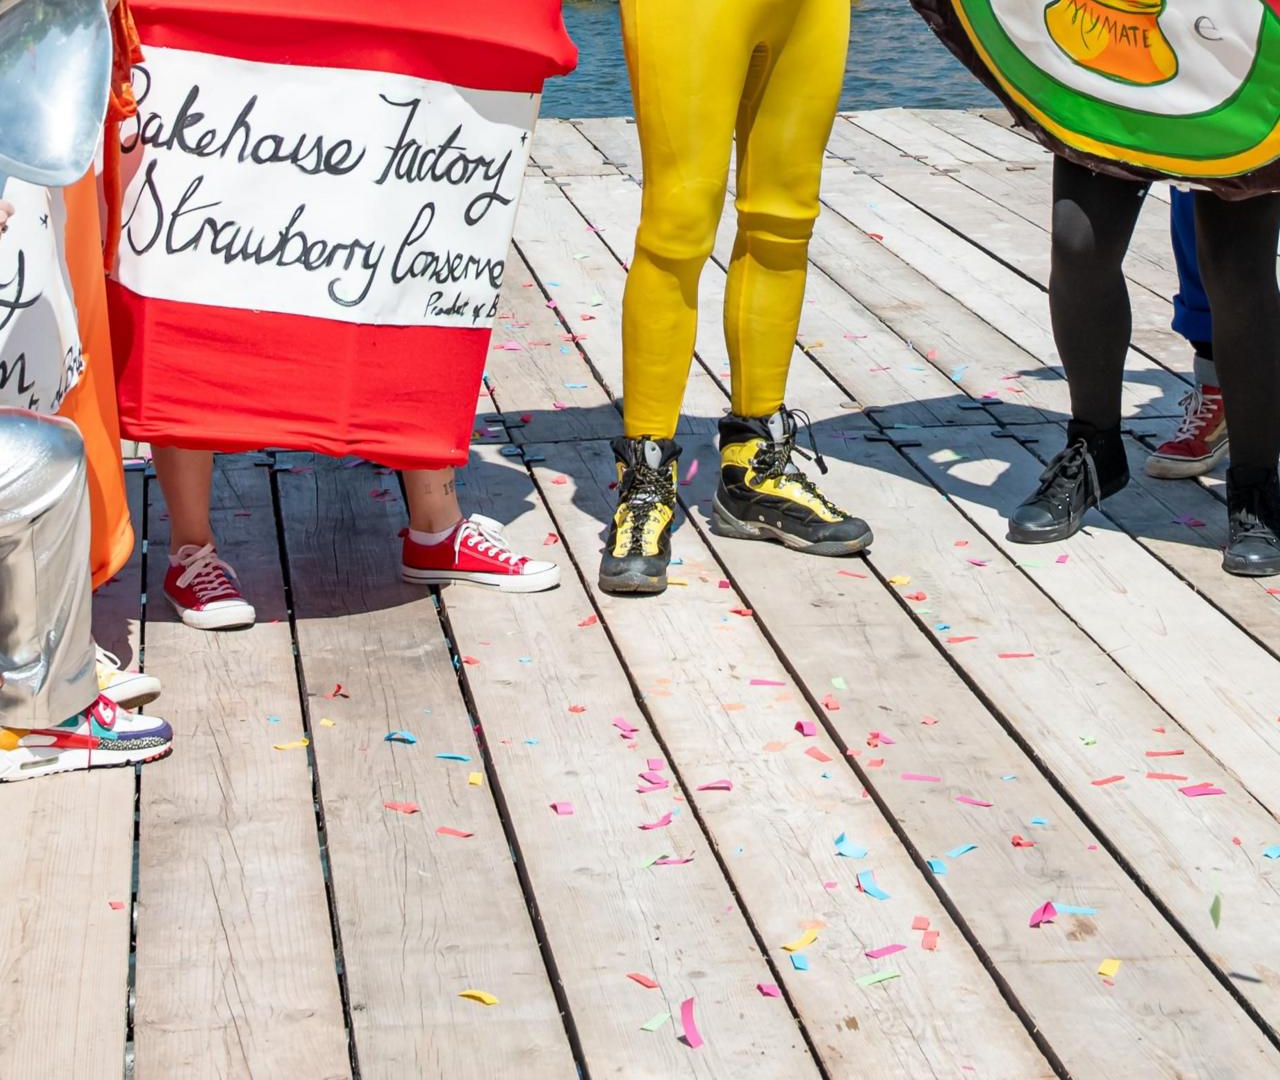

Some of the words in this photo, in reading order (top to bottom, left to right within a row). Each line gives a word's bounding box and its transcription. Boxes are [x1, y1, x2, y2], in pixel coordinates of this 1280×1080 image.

[120, 64, 365, 176] Bakehouse
[373, 92, 515, 226] Factory
[120, 158, 386, 308] Strawberry
[391, 201, 505, 290] Conserve
